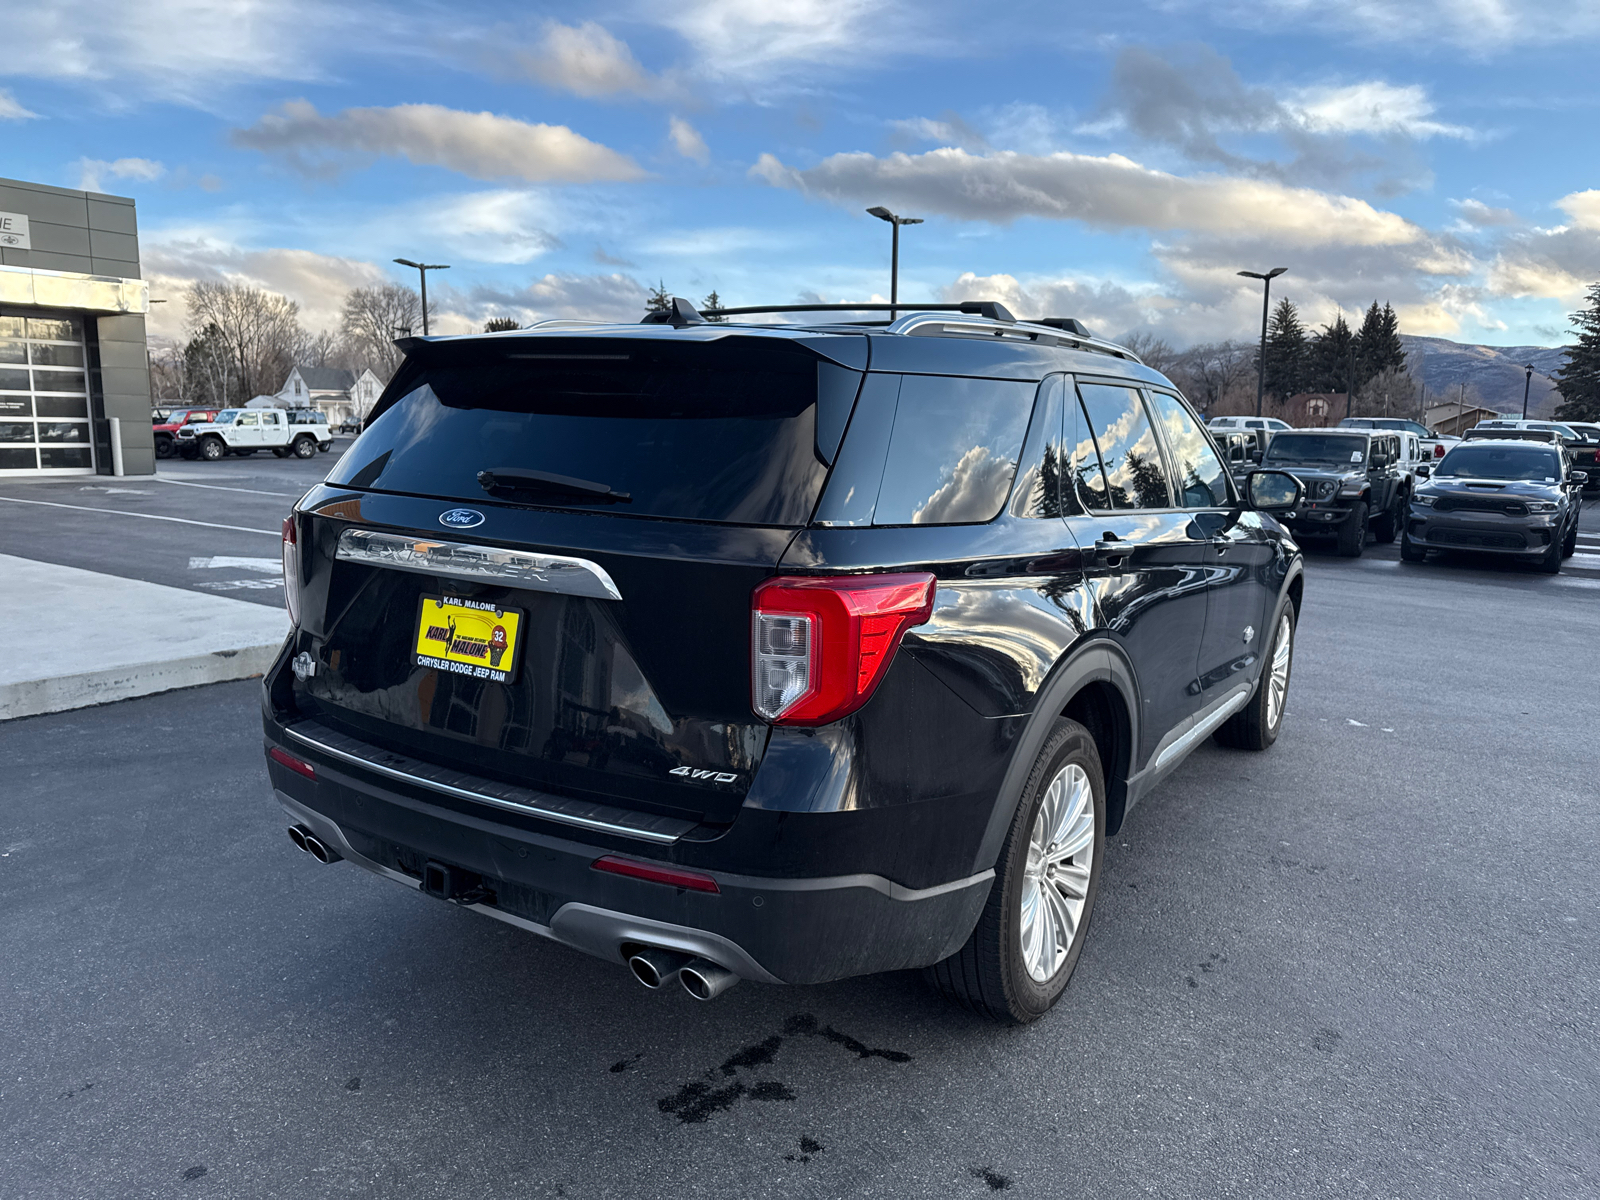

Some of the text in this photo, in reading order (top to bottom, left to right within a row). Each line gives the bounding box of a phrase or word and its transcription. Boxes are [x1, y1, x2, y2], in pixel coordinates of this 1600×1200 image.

[446, 511, 474, 523] Ford
[365, 543, 549, 582] EXPLORER
[443, 596, 496, 612] KARL MALONE
[425, 625, 450, 642] KARL
[494, 631, 504, 642] 32
[450, 640, 489, 659] MALONE
[417, 655, 506, 682] CHRYSLER DODGE JEEP RAM
[668, 766, 738, 783] 4WD
